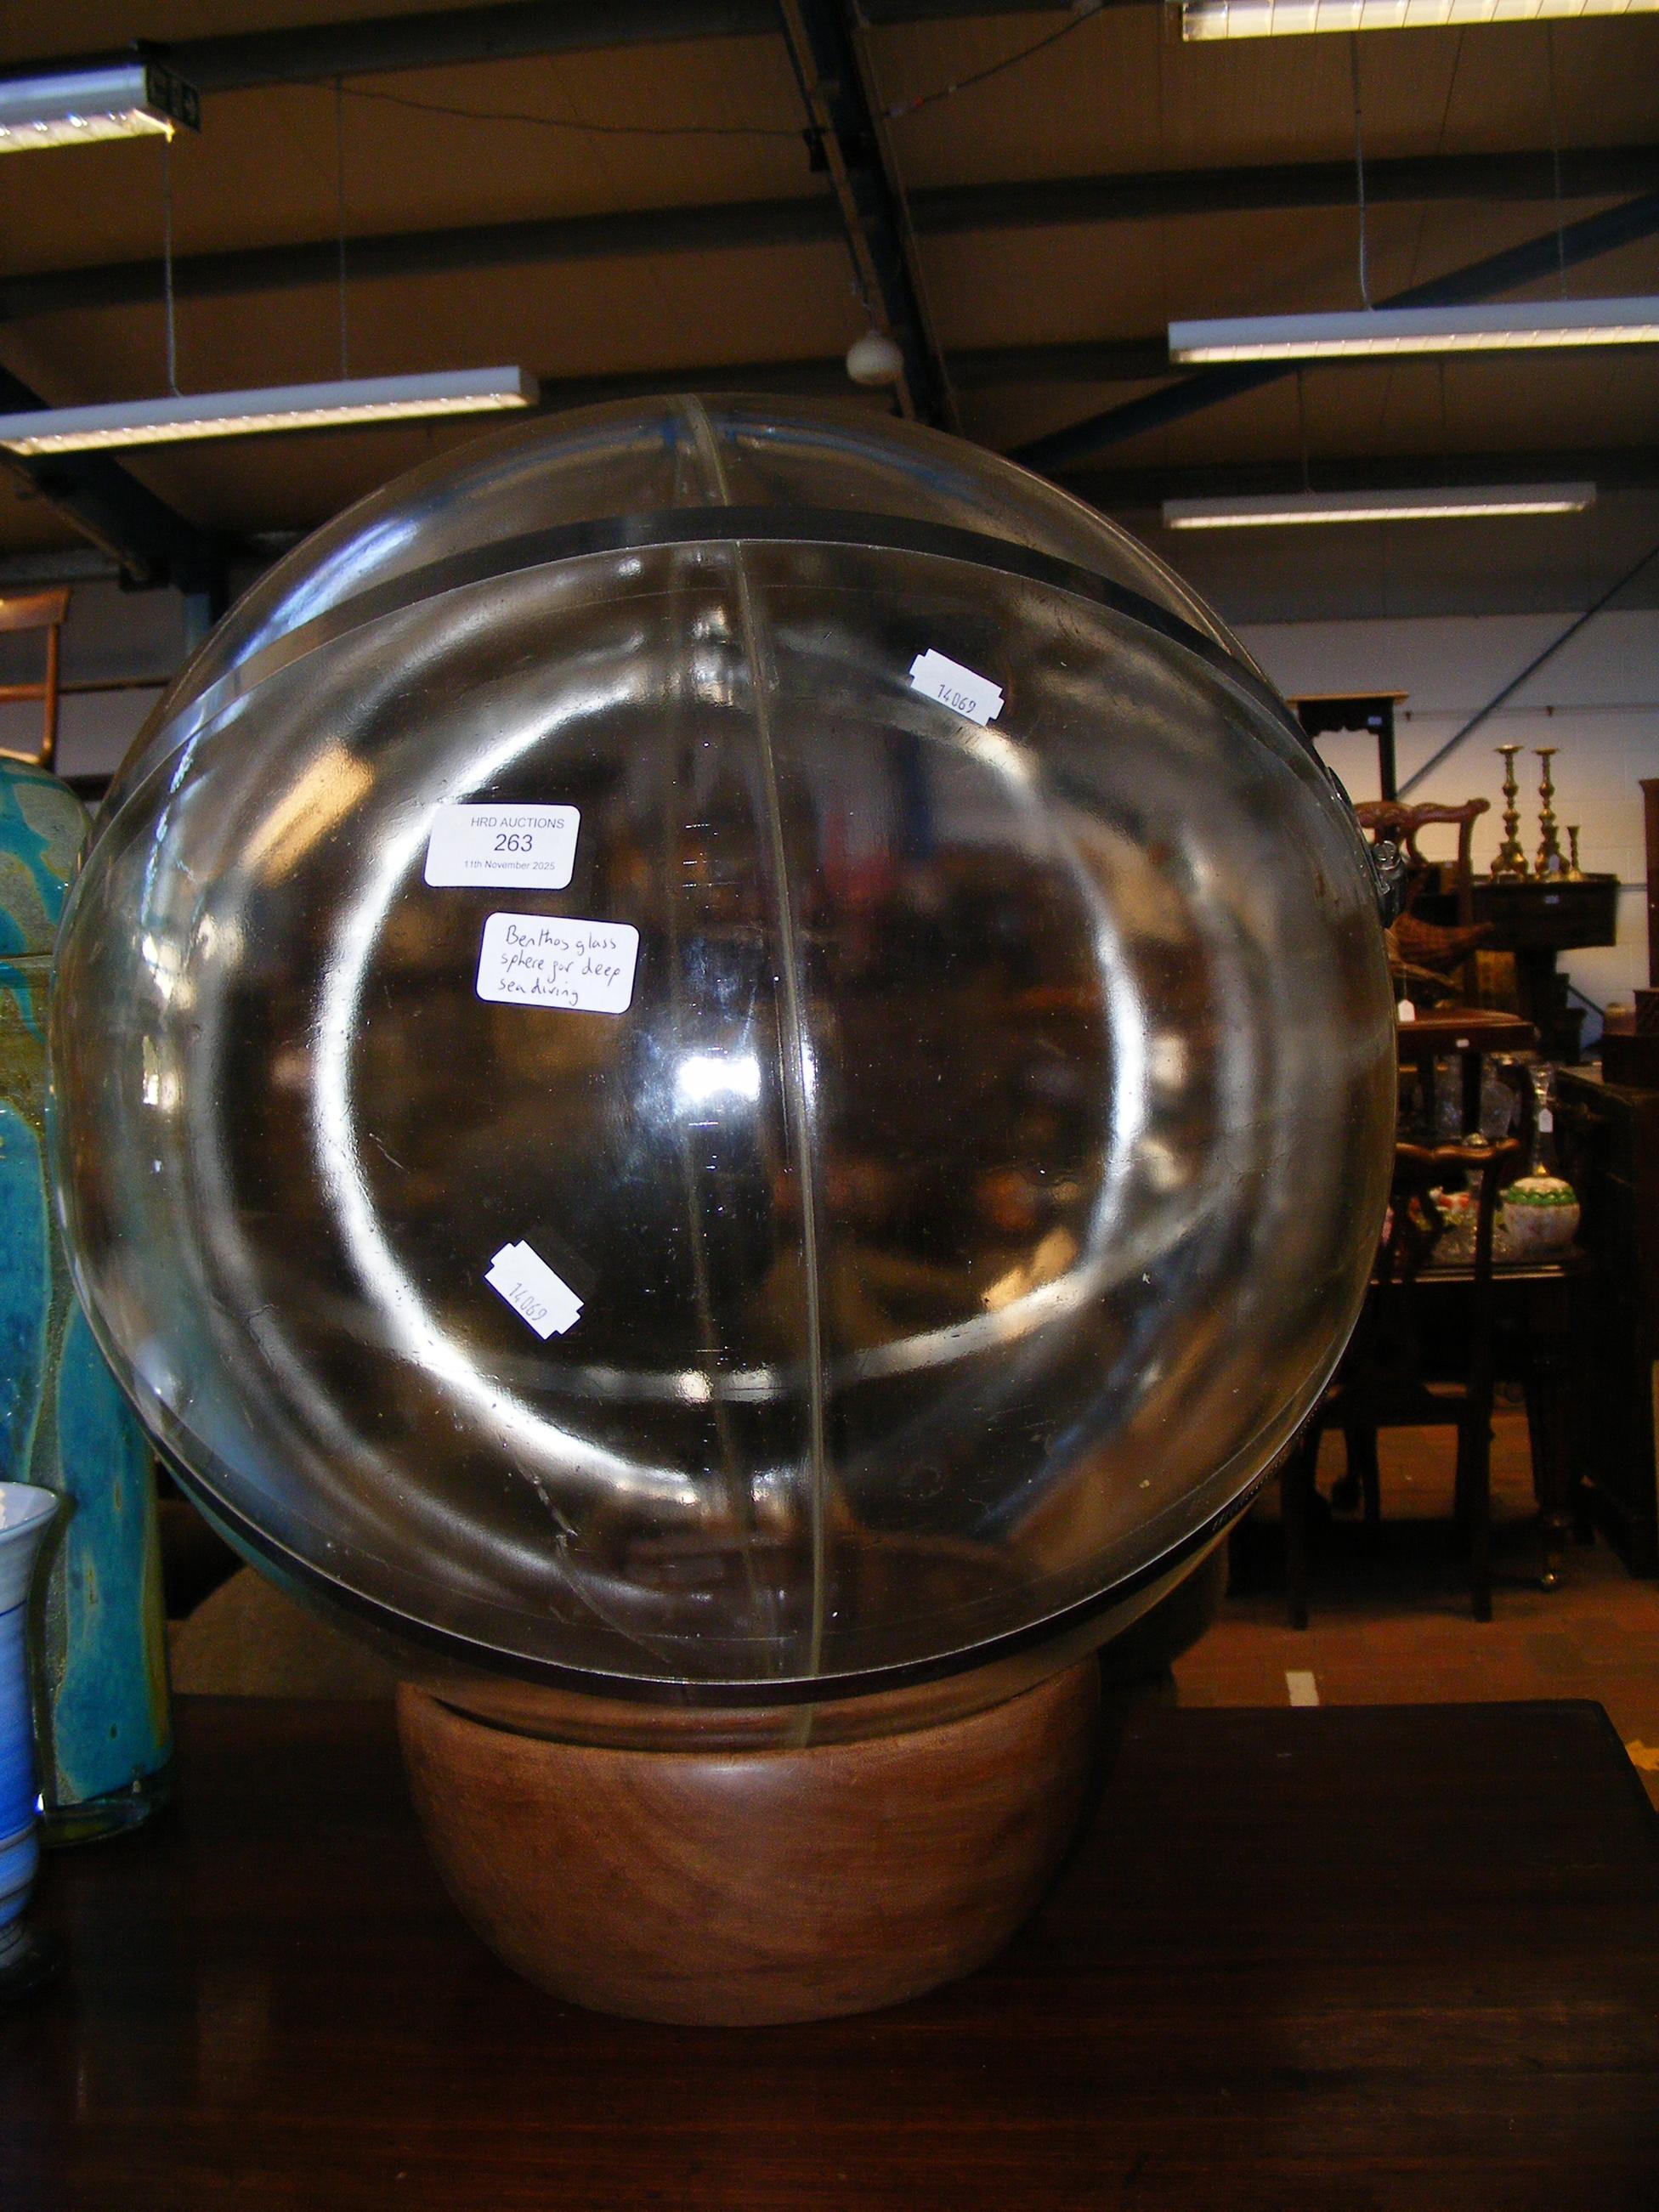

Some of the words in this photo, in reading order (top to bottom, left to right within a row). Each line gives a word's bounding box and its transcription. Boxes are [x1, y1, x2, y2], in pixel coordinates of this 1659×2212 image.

[937, 683, 977, 714] 14069
[470, 817, 497, 828] HRD
[500, 817, 565, 829] AUCTIONS
[494, 833, 533, 852] 263
[464, 860, 483, 869] 11th
[484, 860, 530, 870] November
[532, 861, 556, 871] 2025
[506, 924, 570, 951] Benthos
[575, 931, 617, 957] glass
[500, 949, 545, 973] sphere
[581, 957, 621, 987] deep
[498, 977, 526, 993] sea
[530, 978, 579, 1007] diving
[508, 1281, 548, 1321] 14069
